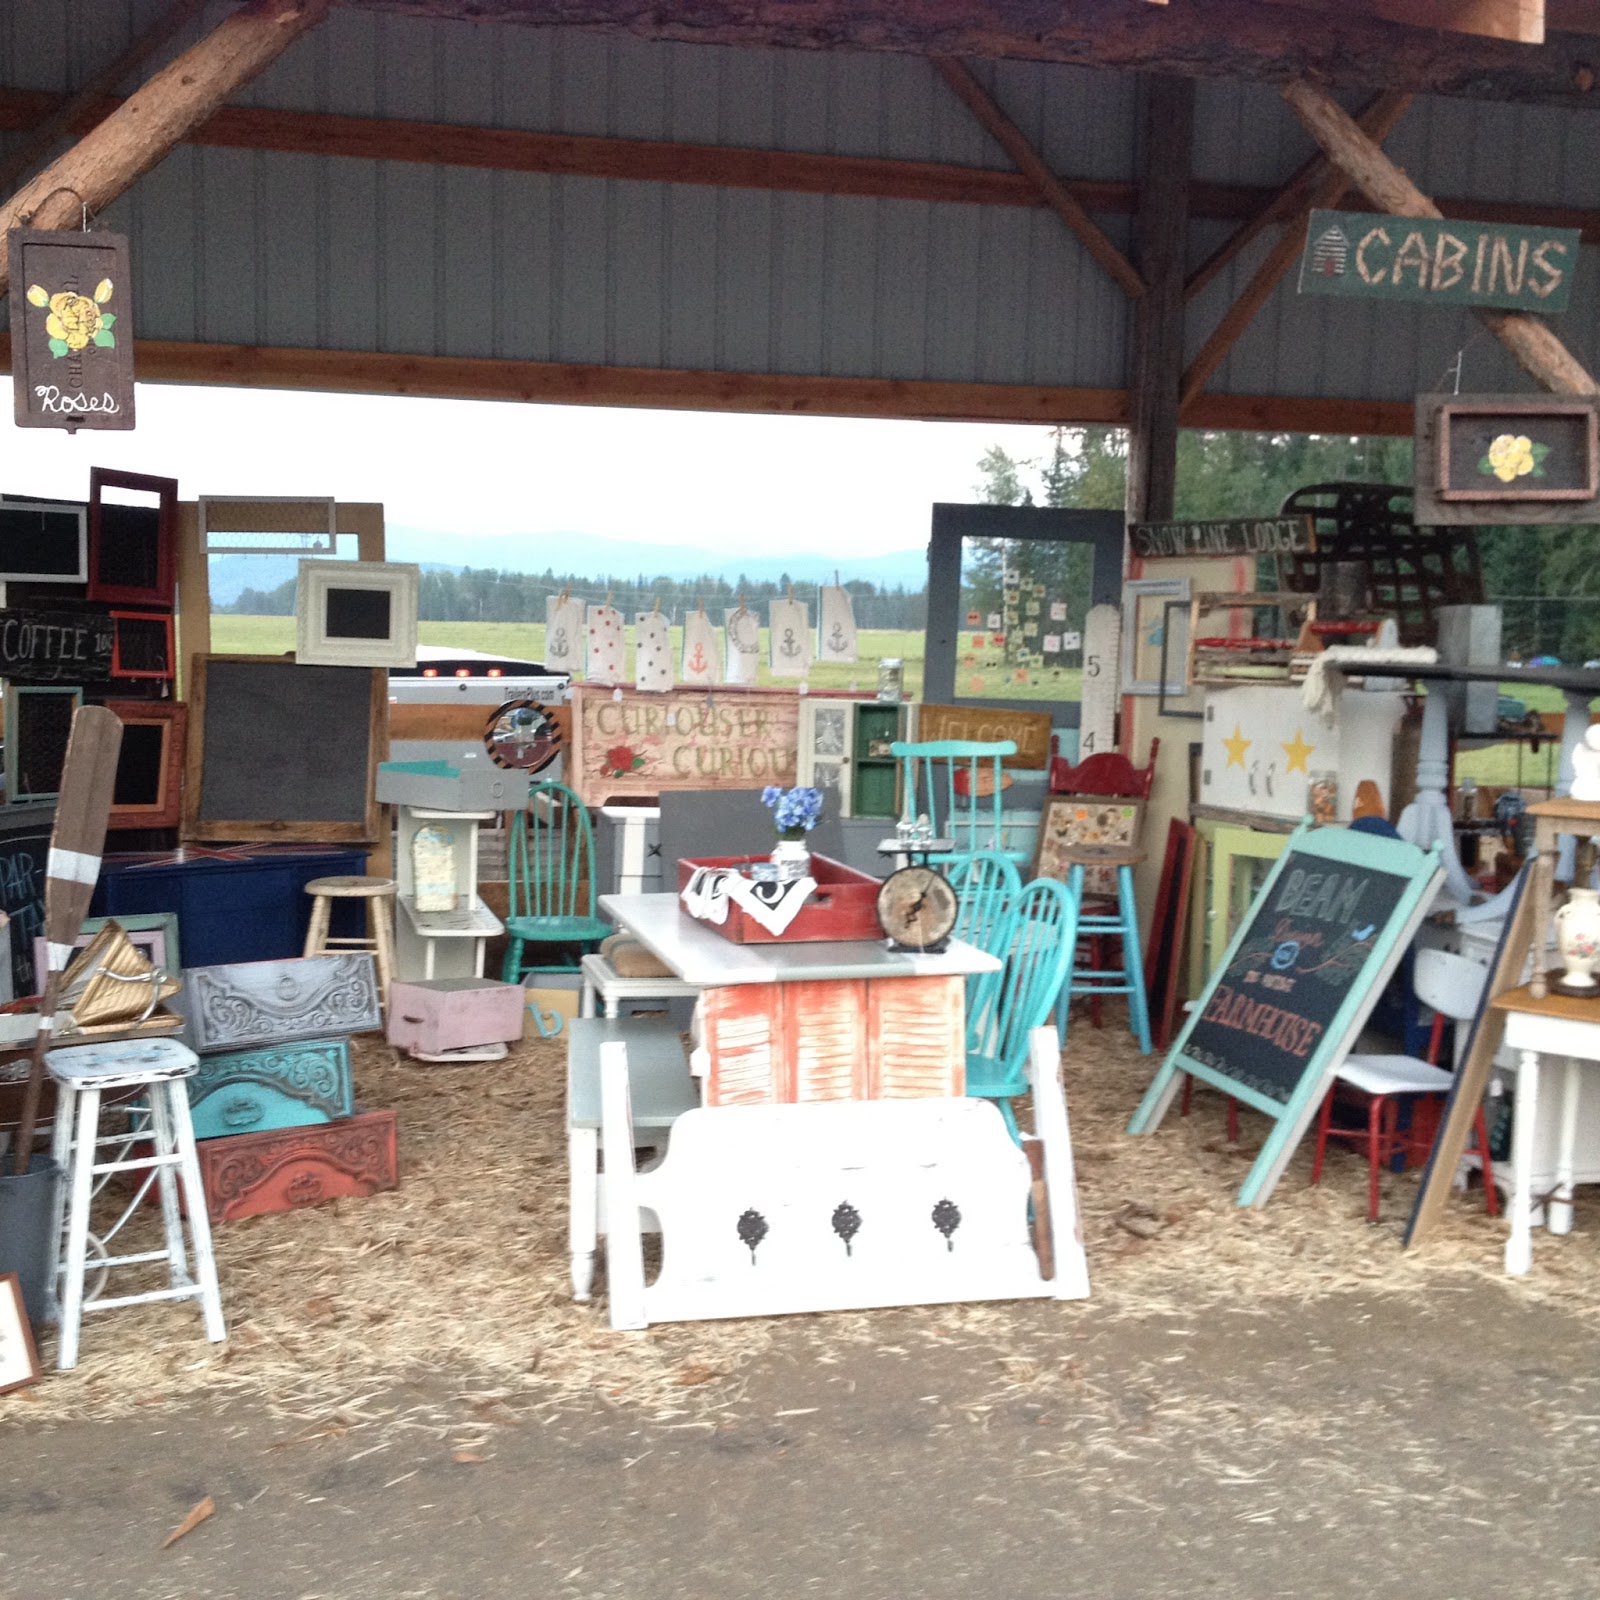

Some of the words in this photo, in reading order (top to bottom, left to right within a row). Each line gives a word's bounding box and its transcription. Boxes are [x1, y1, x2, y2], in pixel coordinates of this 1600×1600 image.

[1355, 227, 1567, 298] CABINS
[34, 385, 120, 414] Roses
[3, 620, 88, 662] COFFEE
[1088, 656, 1101, 677] 5
[1083, 732, 1095, 752] 4
